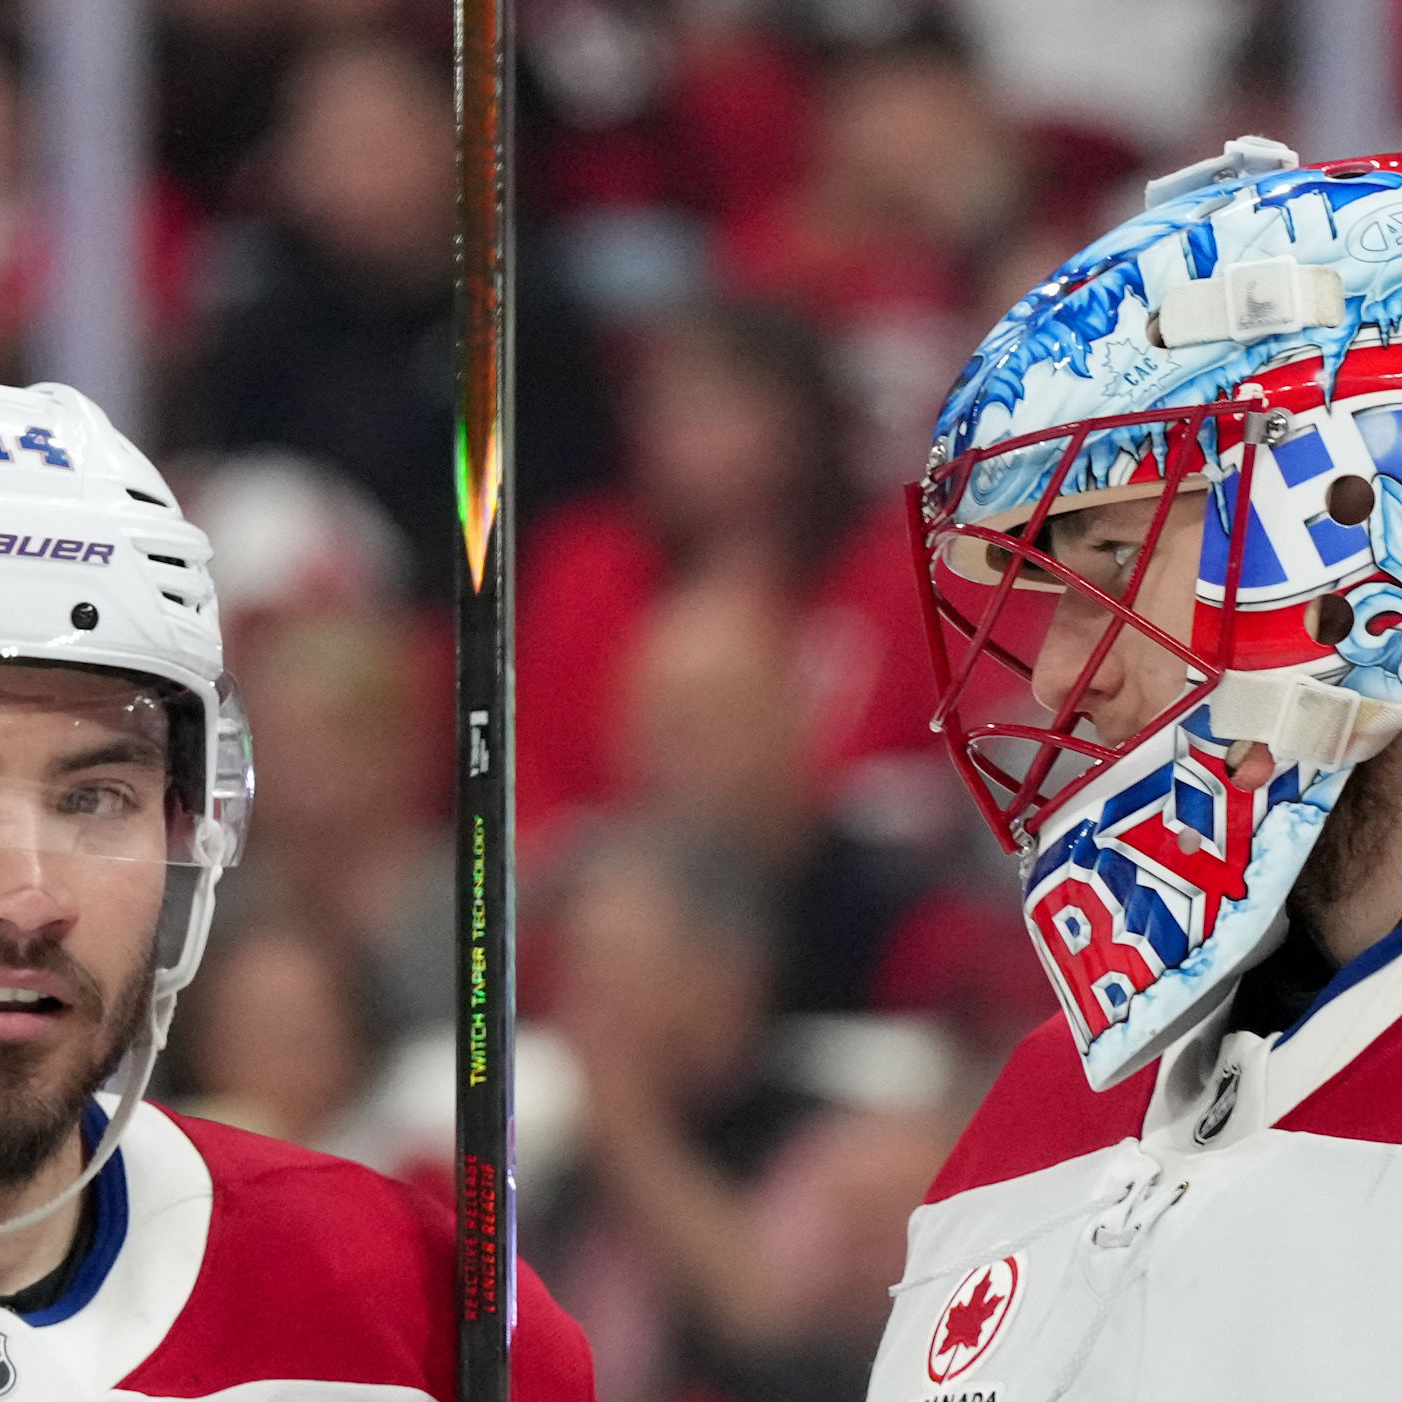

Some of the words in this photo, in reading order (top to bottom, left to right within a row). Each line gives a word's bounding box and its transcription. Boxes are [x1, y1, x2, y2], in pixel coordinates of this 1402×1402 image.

[1124, 357, 1159, 386] CAC
[471, 947, 487, 1008] TAPER
[470, 1013, 488, 1087] TWITCH
